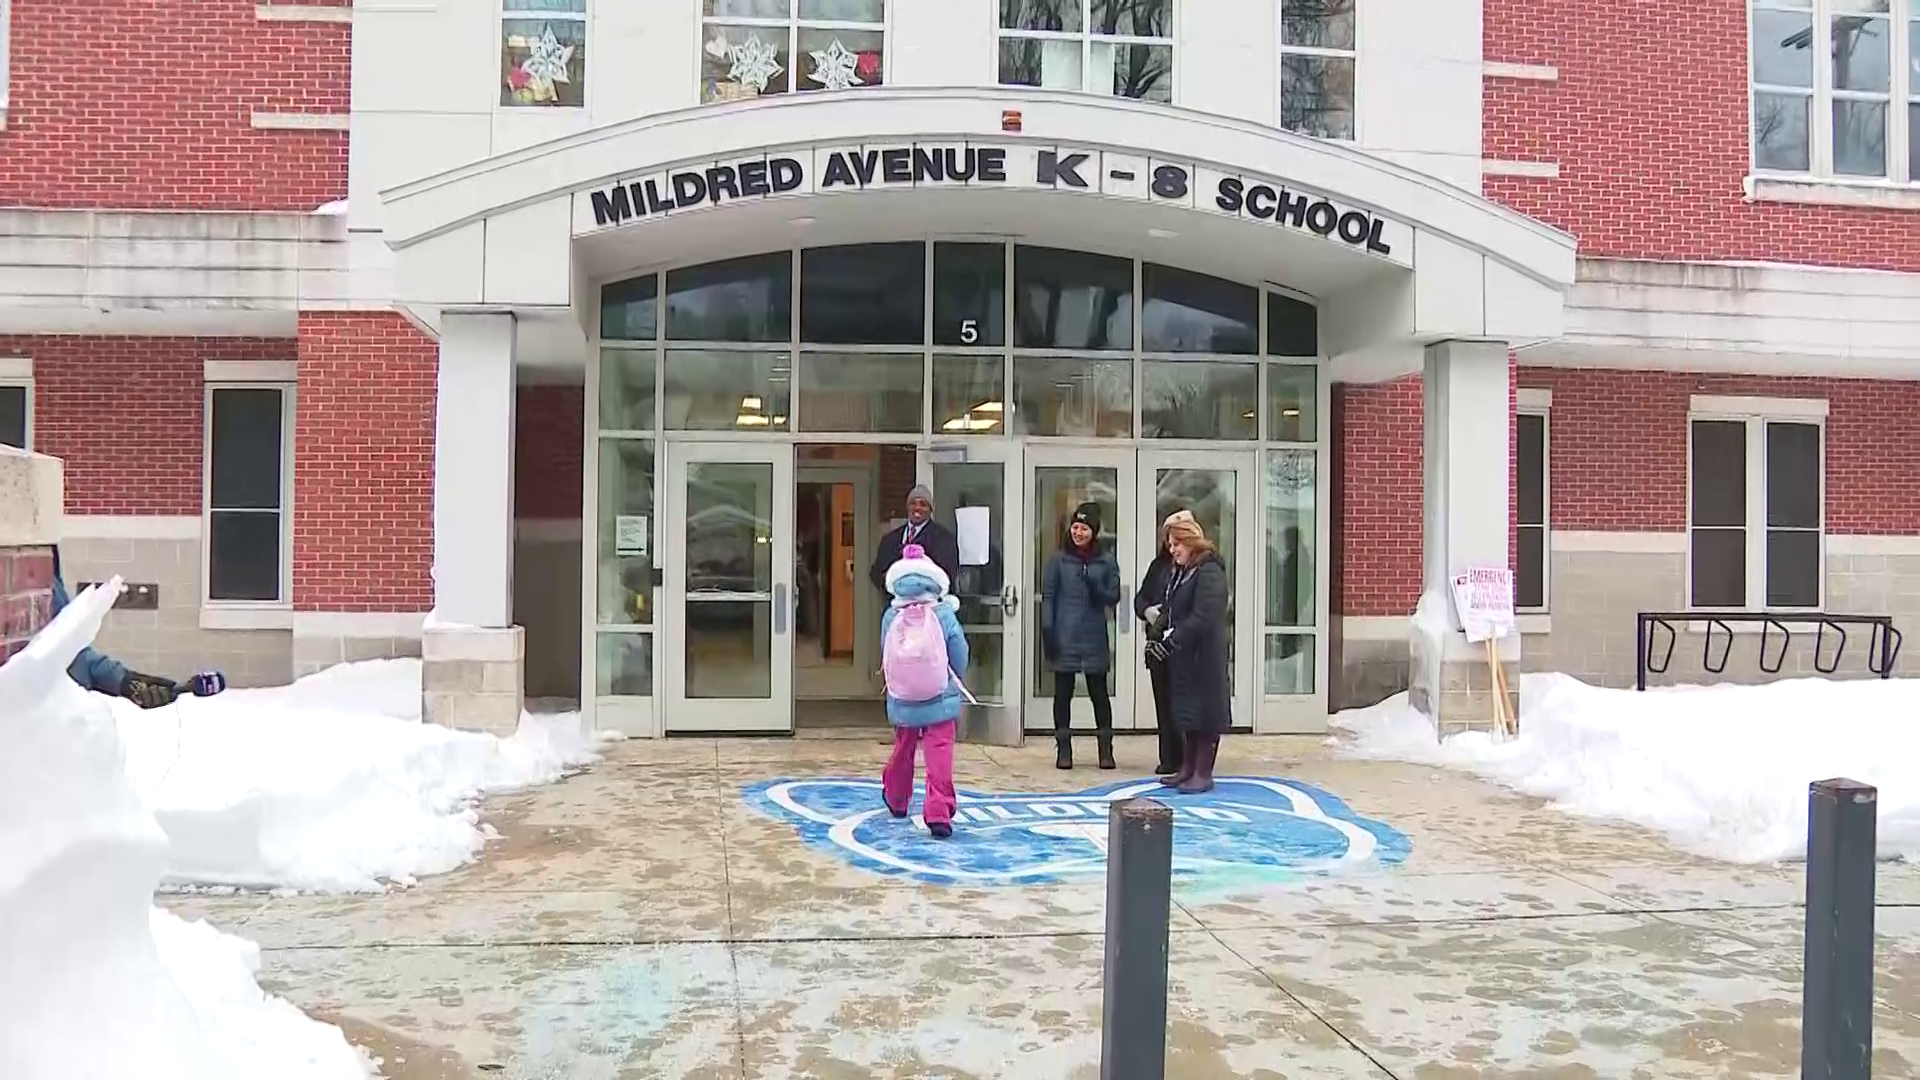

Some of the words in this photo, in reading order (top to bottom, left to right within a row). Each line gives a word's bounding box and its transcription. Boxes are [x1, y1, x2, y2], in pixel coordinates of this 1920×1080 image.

[591, 157, 804, 226] MILDRED
[822, 147, 1007, 188] AVENUE
[1215, 178, 1391, 255] SCHOOL
[961, 320, 978, 343] 5
[910, 802, 1253, 834] MILDD
